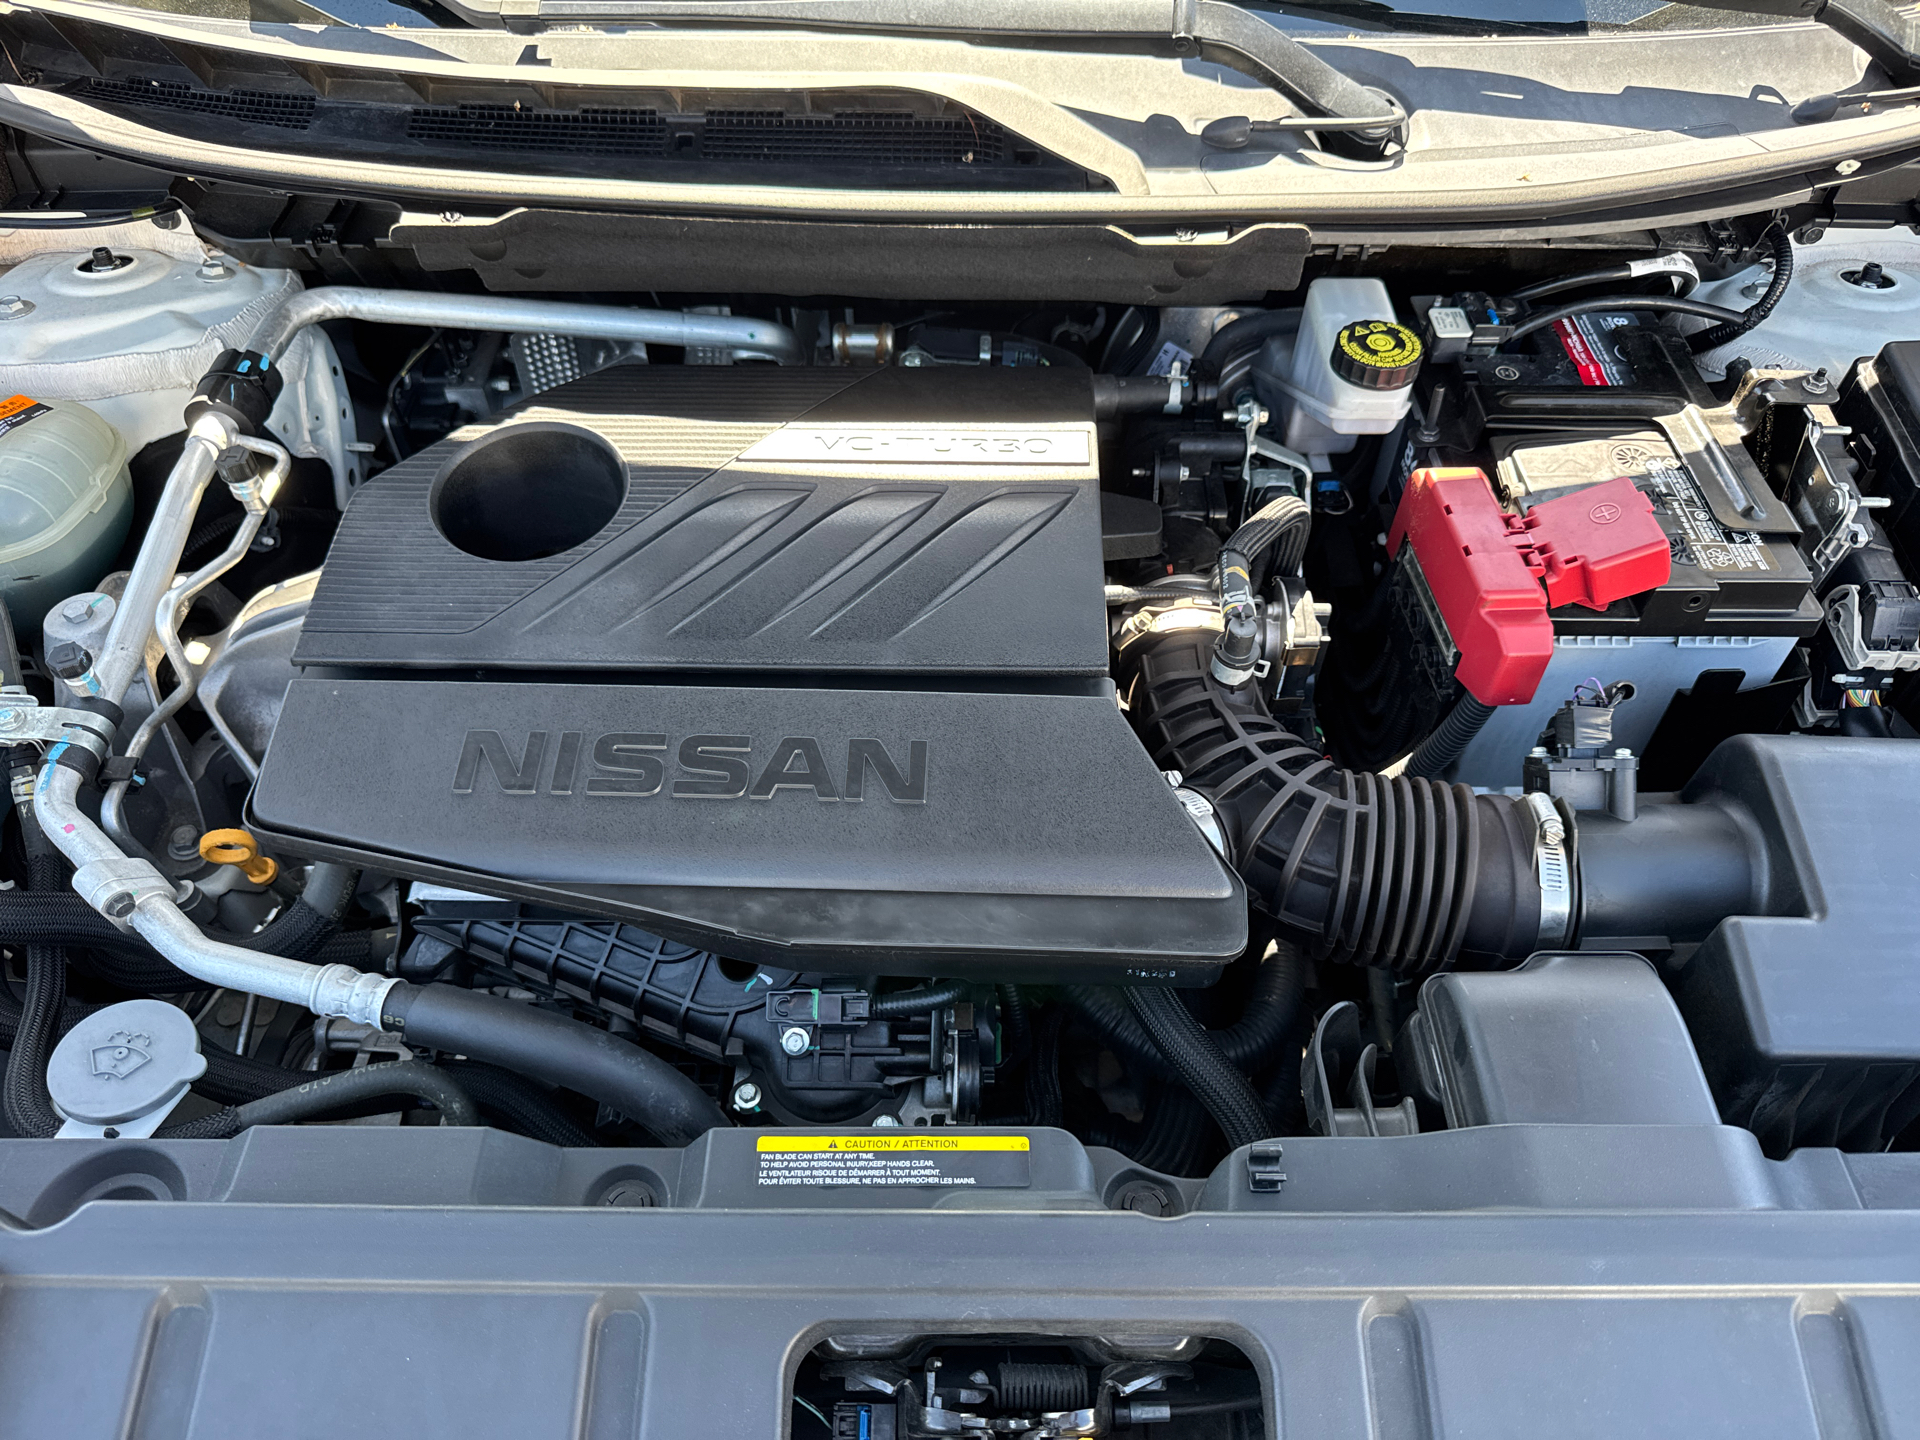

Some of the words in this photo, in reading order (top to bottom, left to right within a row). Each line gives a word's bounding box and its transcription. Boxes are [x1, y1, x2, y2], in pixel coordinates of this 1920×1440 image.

[814, 436, 1053, 453] VC-TURBO
[452, 729, 929, 804] NISSAN
[845, 1140, 891, 1148] CAUTION
[902, 1140, 958, 1148] ATTENTION
[849, 1168, 885, 1176] DÉMARRER
[779, 1177, 801, 1185] ÉVITER
